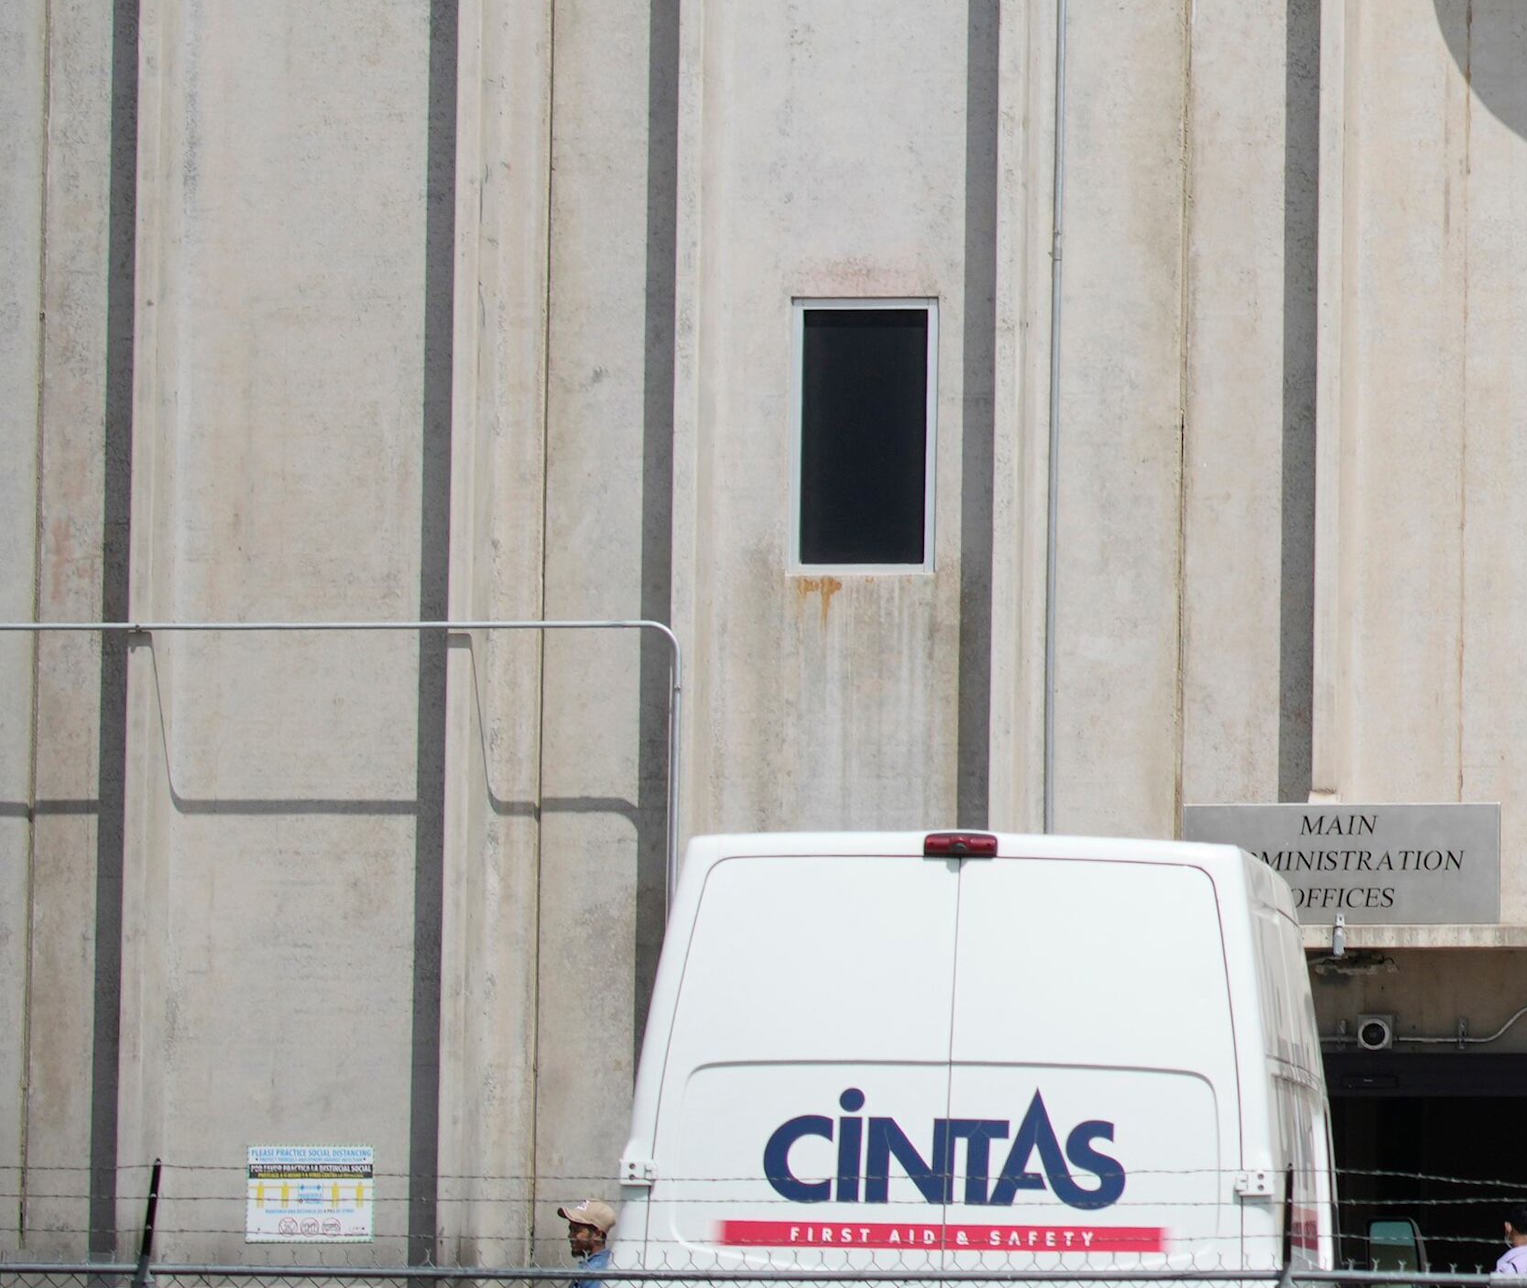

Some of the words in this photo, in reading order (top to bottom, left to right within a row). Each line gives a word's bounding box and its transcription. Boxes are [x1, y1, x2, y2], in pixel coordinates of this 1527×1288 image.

[1300, 814, 1379, 836] MAIN
[1250, 850, 1465, 872] MINISTRATION
[251, 1148, 274, 1157] PLEASE
[276, 1148, 307, 1157] PRACTICE
[308, 1148, 330, 1157] SOCIAL
[332, 1148, 372, 1157] DISTANCING
[789, 1227, 871, 1243] FIRST
[889, 1229, 936, 1244] AID
[956, 1230, 969, 1245] &
[989, 1231, 1096, 1247] SAFETY
